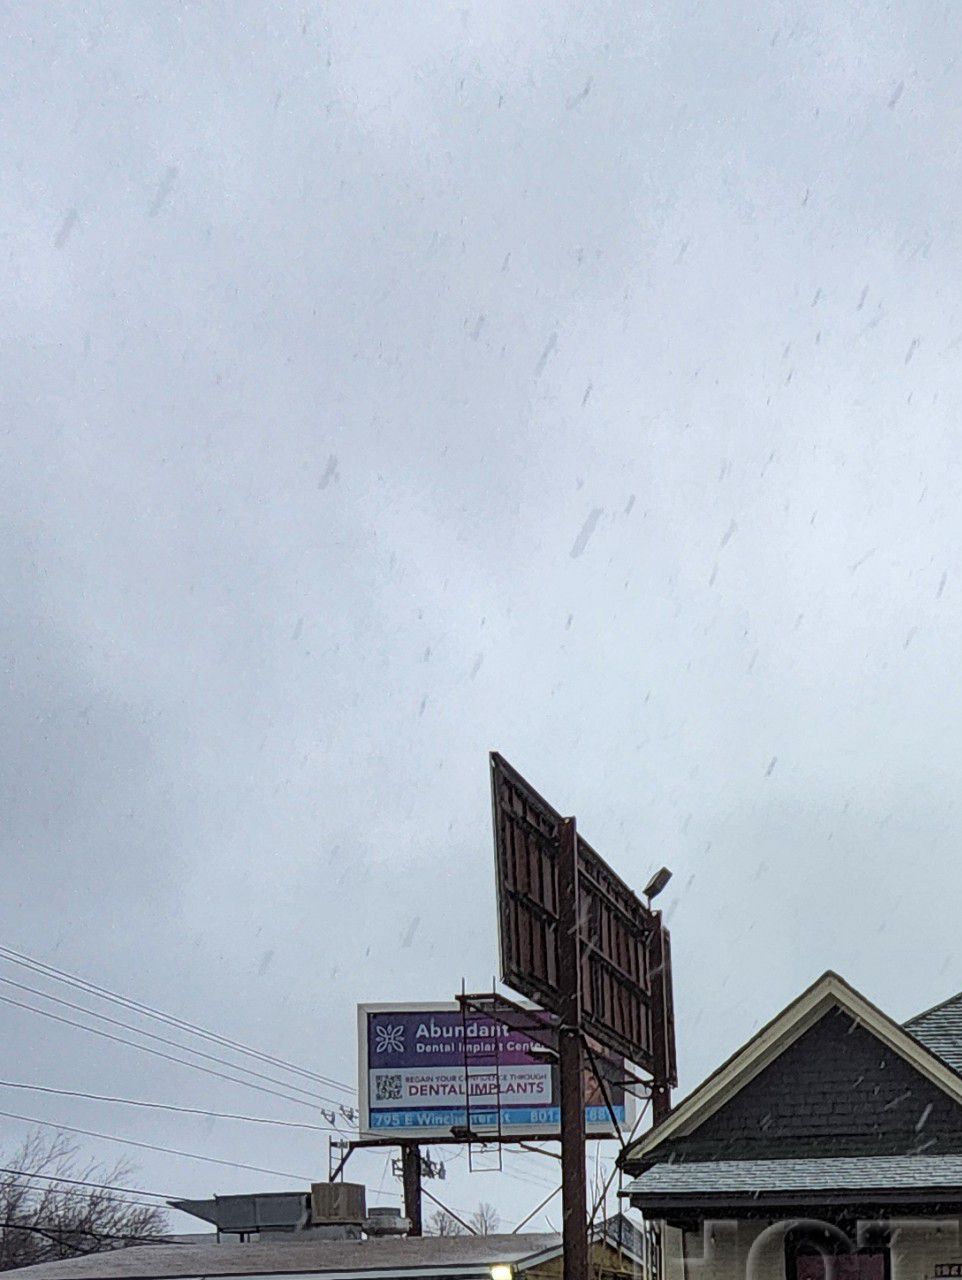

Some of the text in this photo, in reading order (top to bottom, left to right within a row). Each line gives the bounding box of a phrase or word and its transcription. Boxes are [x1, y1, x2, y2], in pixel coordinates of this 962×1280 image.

[416, 1022, 509, 1038] Abundant
[416, 1042, 455, 1053] Dental
[409, 1082, 544, 1096] DENTAL IMPLANTS
[374, 1113, 400, 1127] 795
